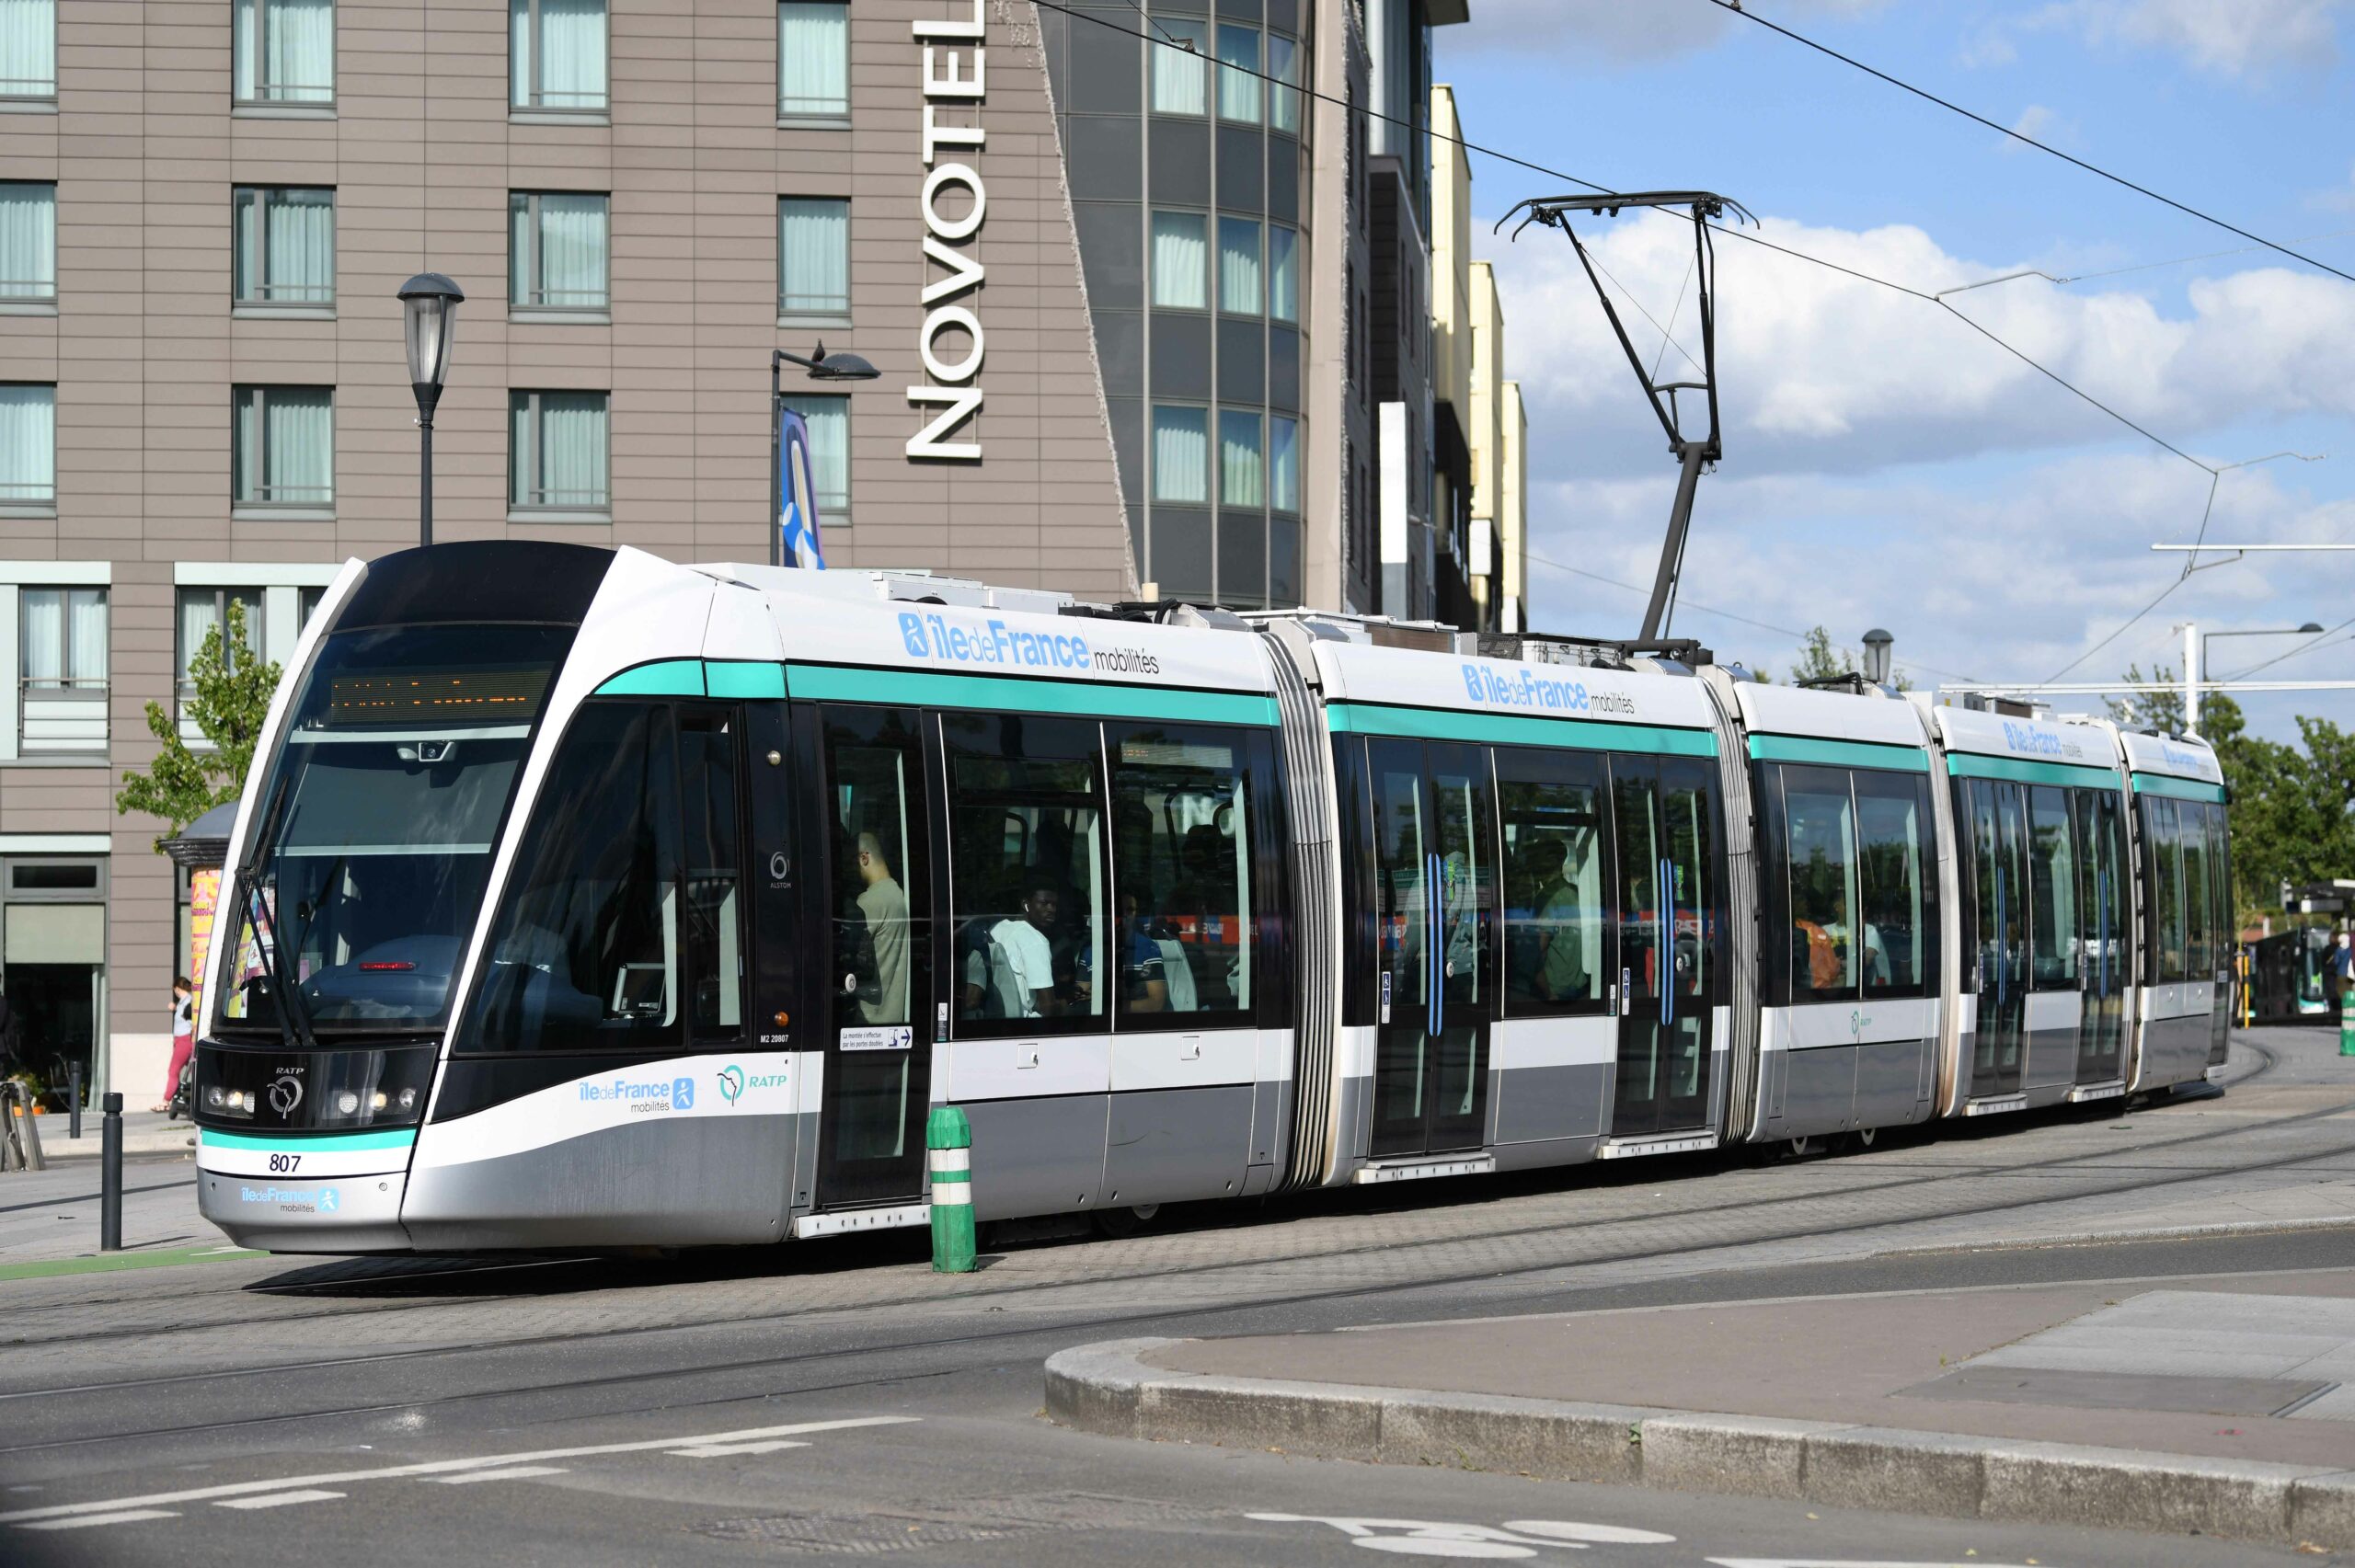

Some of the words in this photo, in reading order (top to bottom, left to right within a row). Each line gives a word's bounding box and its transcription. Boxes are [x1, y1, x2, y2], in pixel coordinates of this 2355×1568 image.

[905, 0, 985, 459] NOVOTEL
[1094, 647, 1160, 675] mobilités
[1591, 691, 1635, 715] mobilités
[760, 1035, 770, 1043] M2
[276, 1067, 304, 1075] RATP
[749, 1075, 787, 1088] RATP
[630, 1100, 670, 1113] mobilités
[269, 1153, 302, 1173] 807
[280, 1204, 316, 1213] mobilités
